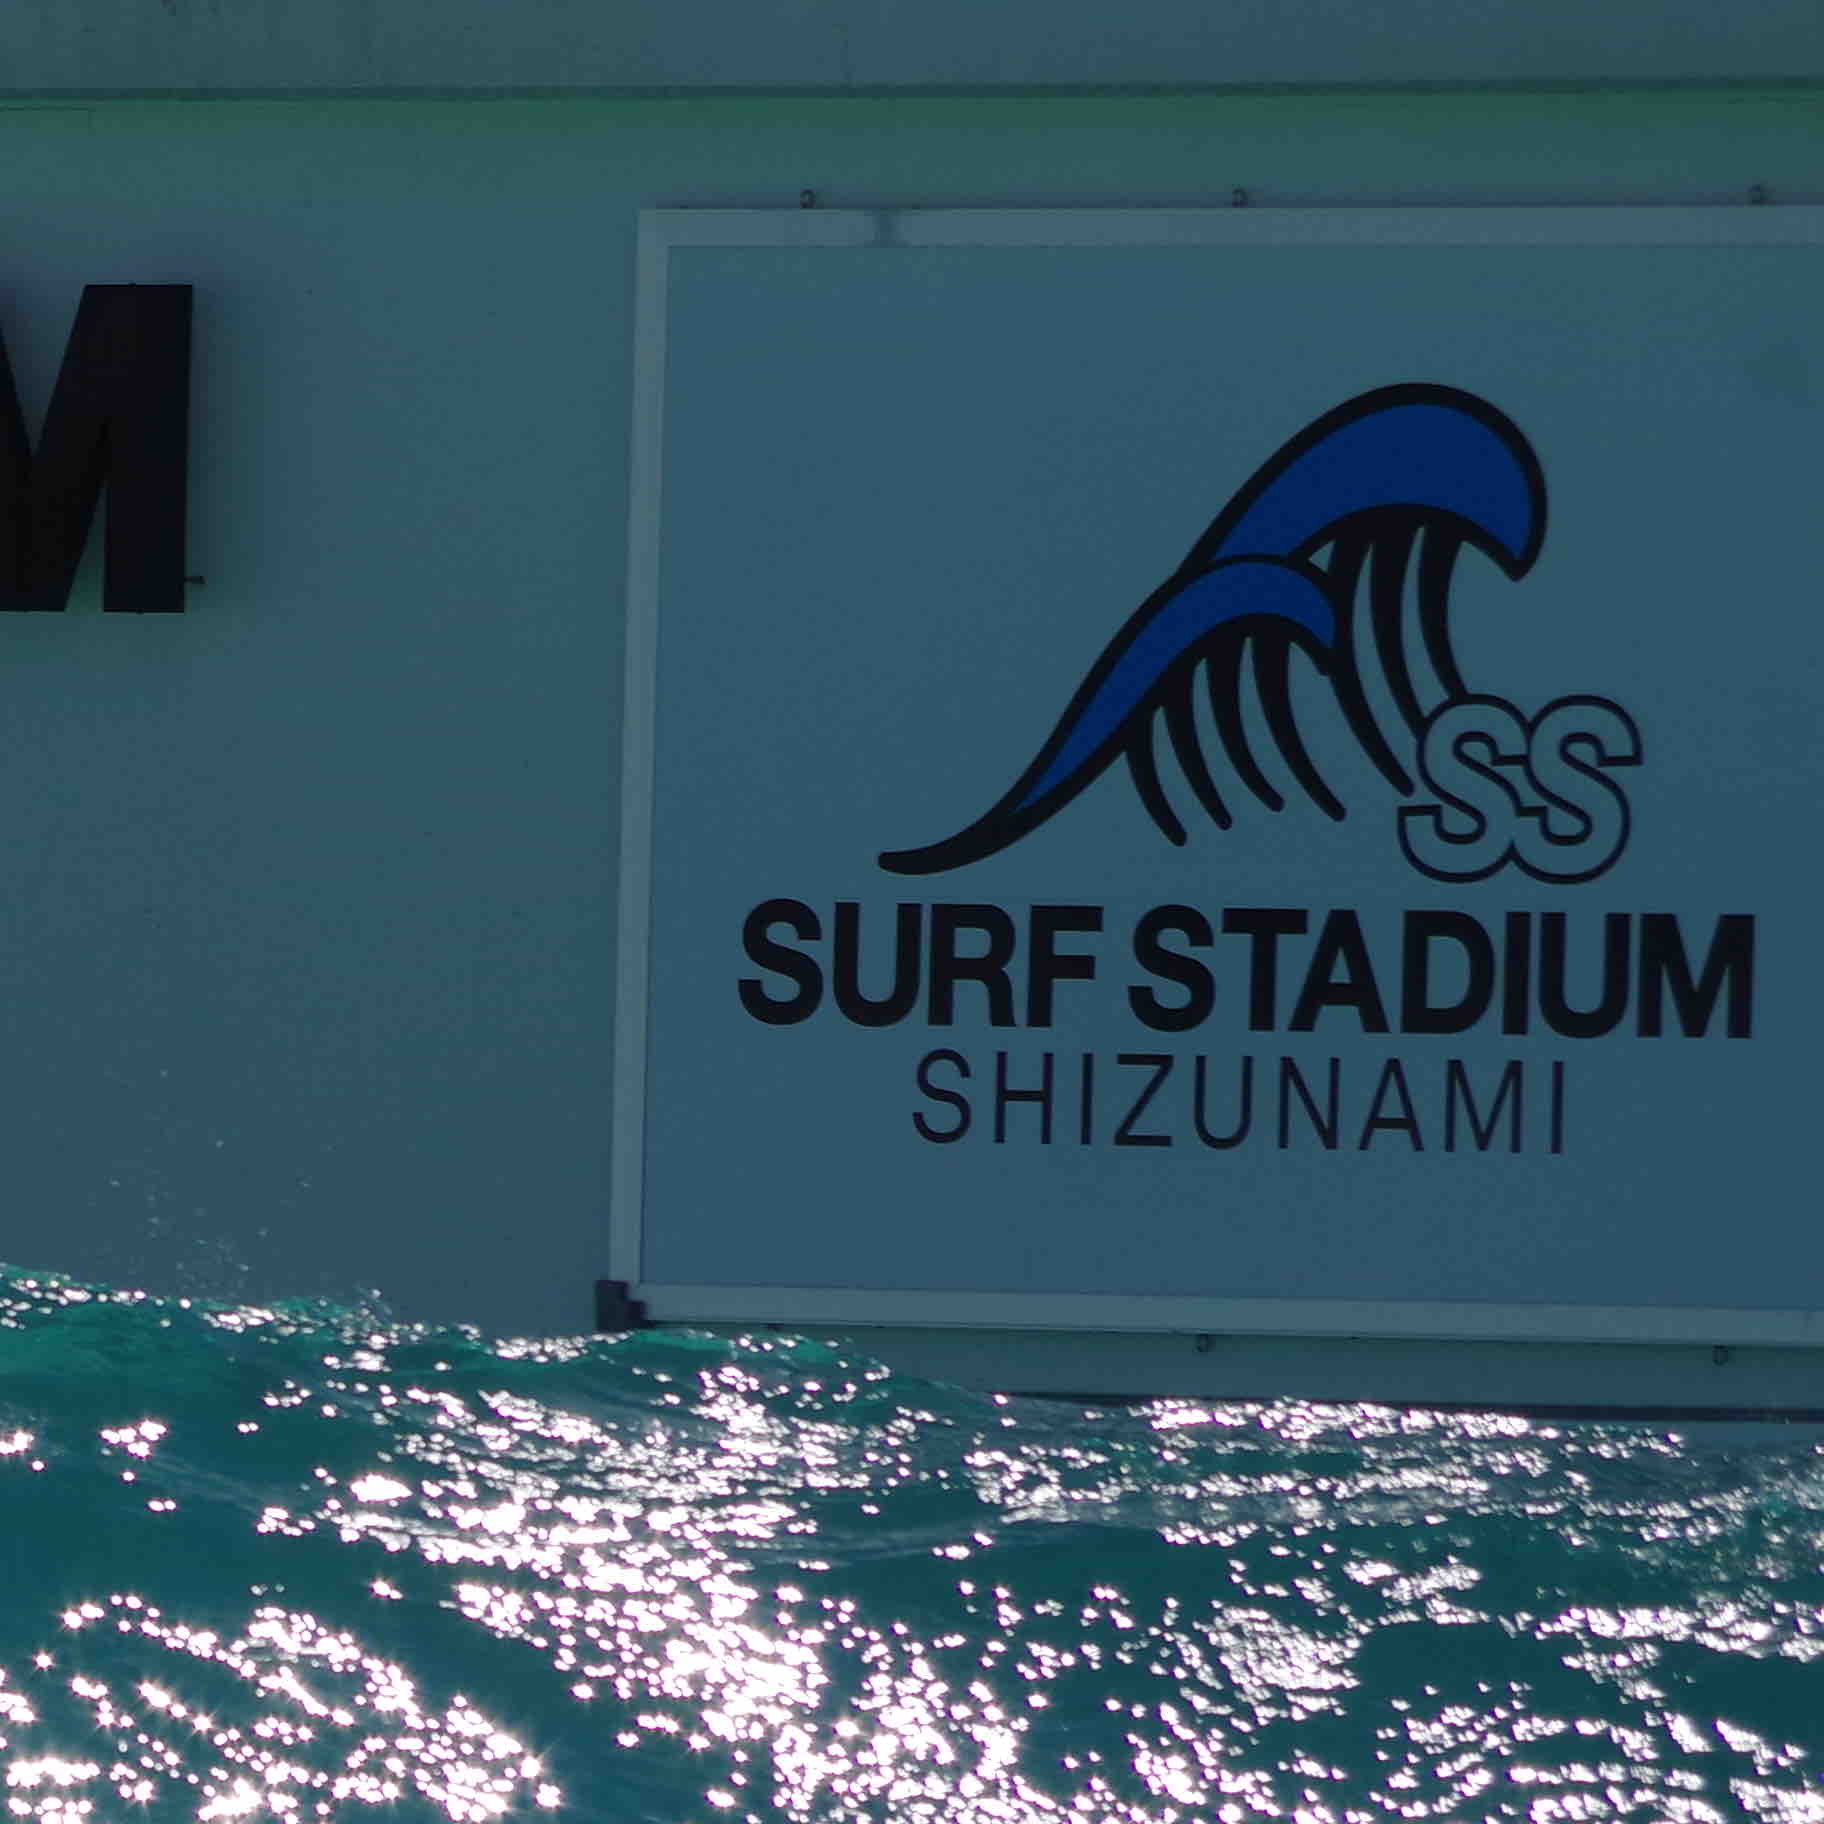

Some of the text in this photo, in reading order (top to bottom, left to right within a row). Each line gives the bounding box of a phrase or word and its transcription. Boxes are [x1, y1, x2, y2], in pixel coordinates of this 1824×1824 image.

[1397, 693, 1643, 885] SS
[738, 898, 1756, 1040] SURF STADIUM
[912, 1049, 1567, 1156] SHIZUNAMI
